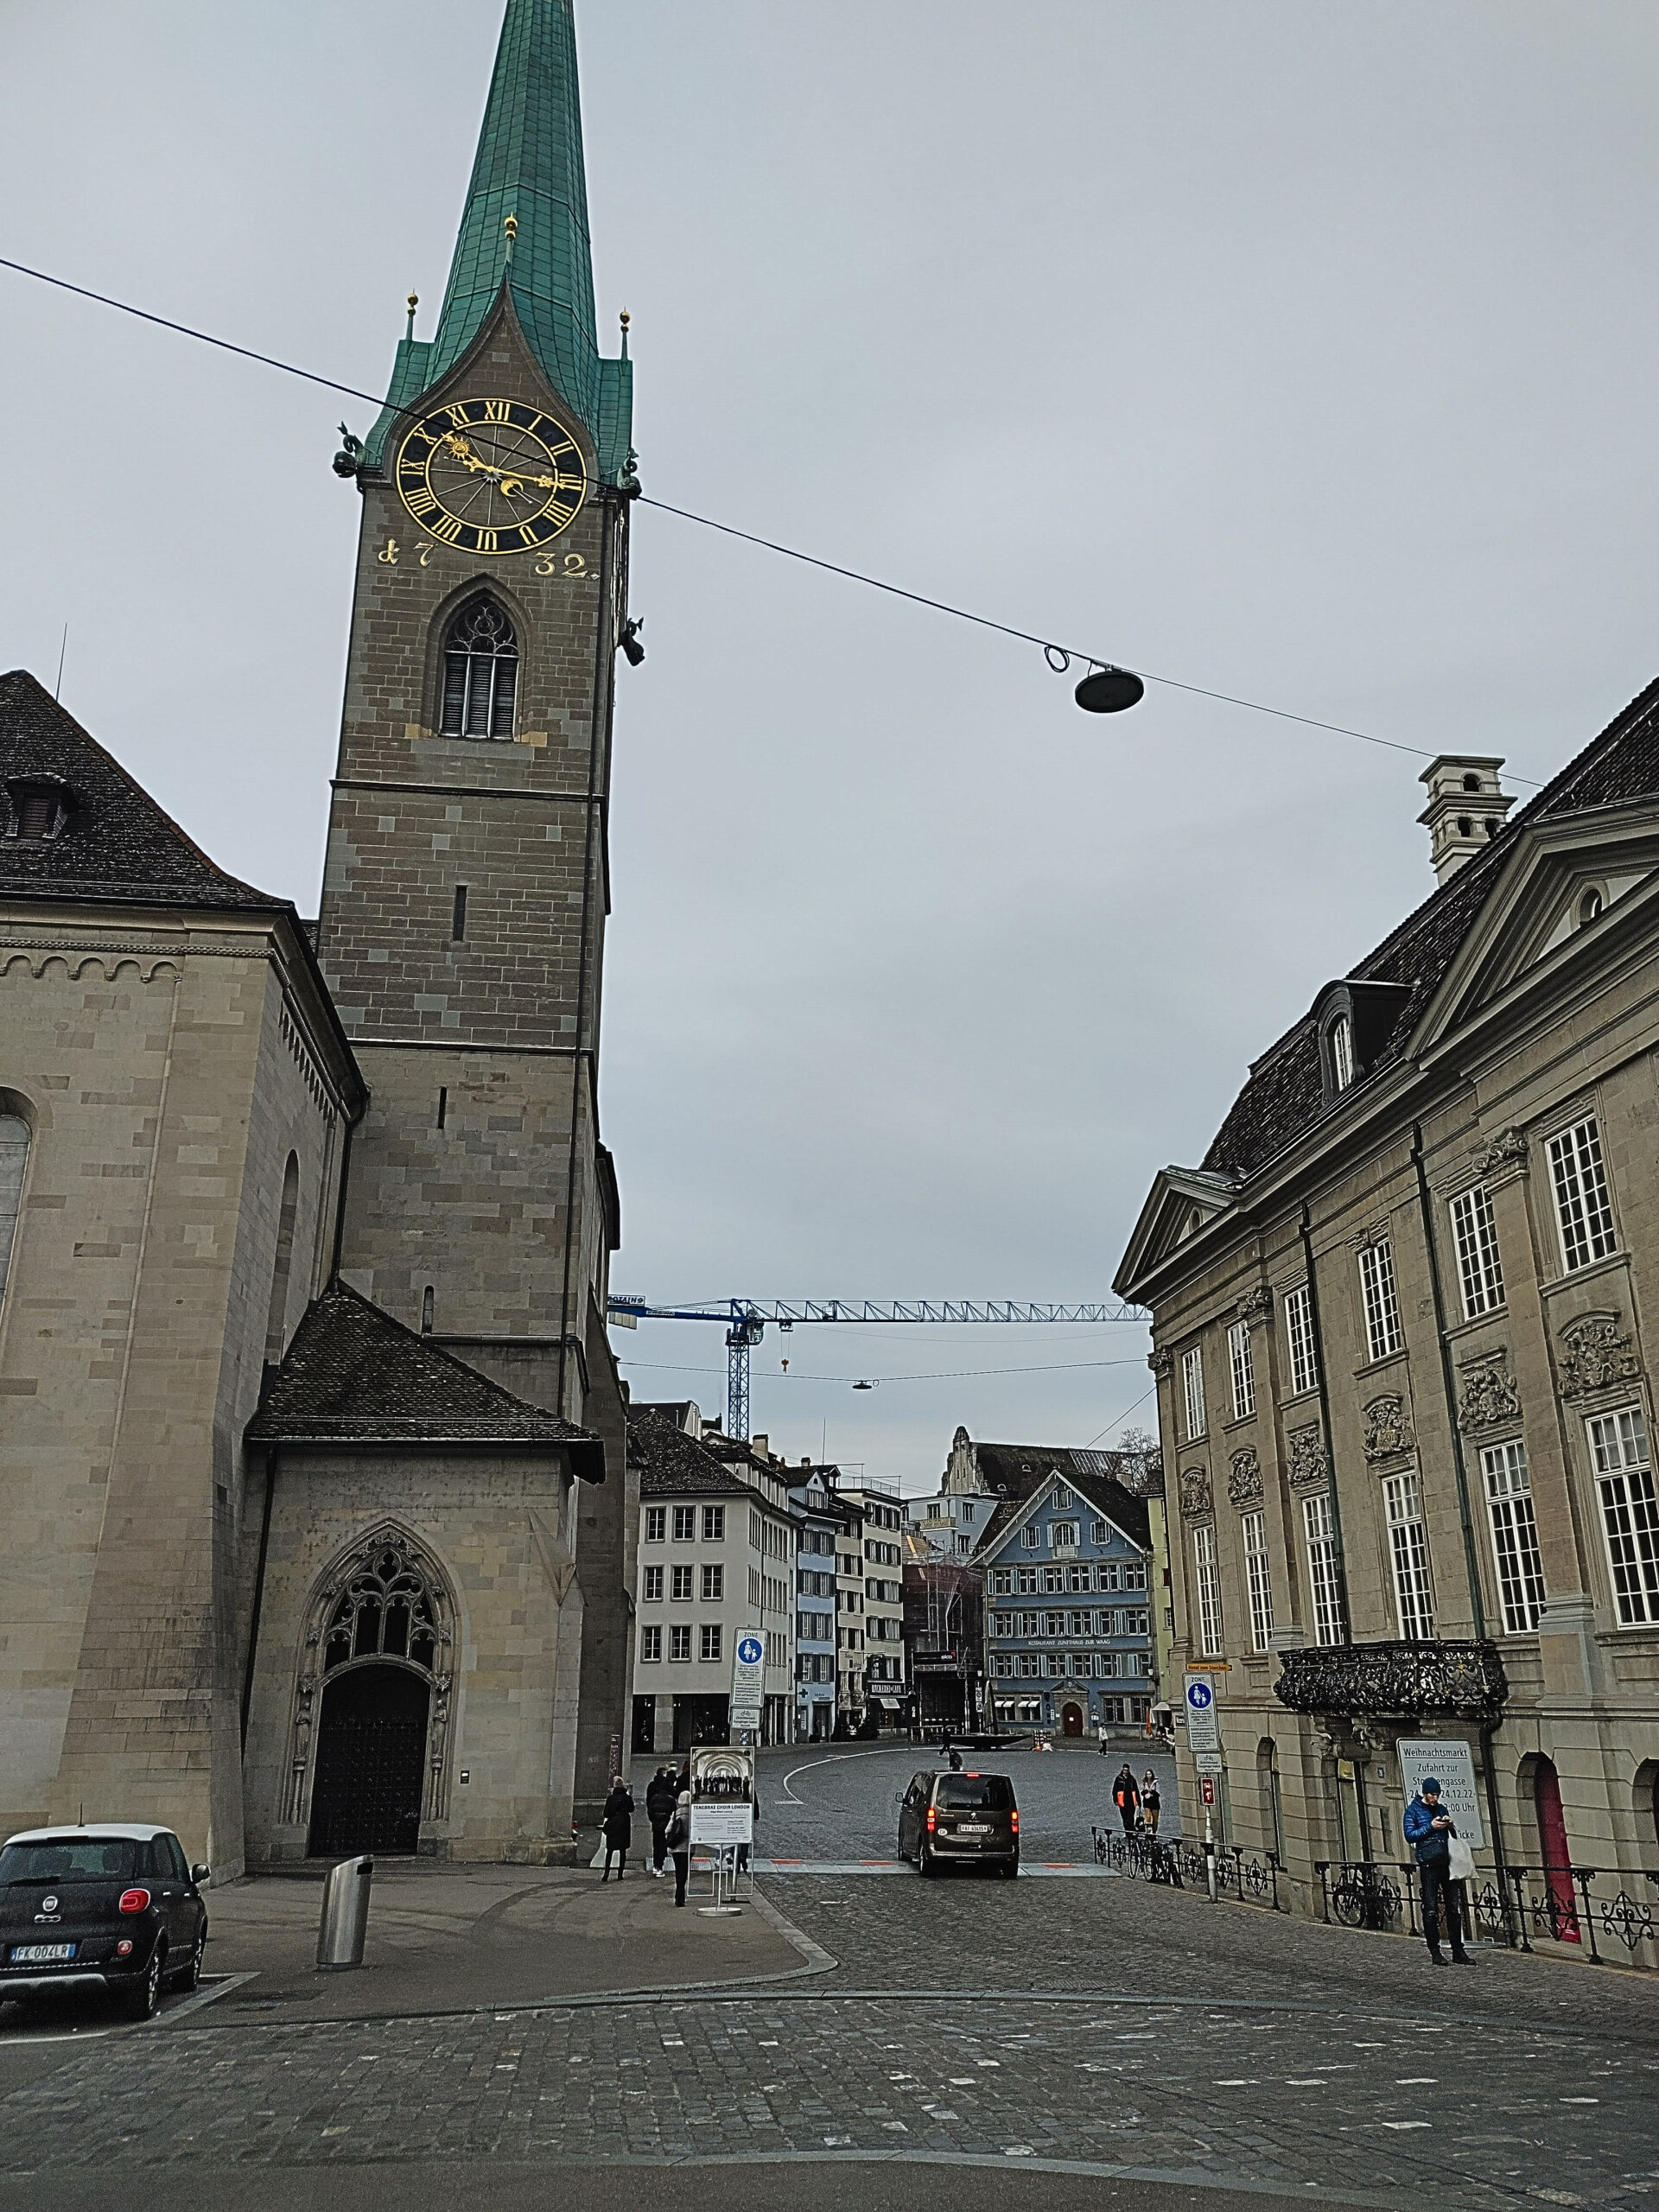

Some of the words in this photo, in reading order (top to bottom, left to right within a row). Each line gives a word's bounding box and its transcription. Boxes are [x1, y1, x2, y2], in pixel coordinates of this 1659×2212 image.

[446, 404, 469, 425] XI
[484, 401, 510, 421] XII
[528, 415, 543, 430] I
[413, 427, 438, 445] X
[550, 441, 575, 456] II
[400, 458, 425, 476] IX
[1403, 1747, 1467, 1757] Weihnachtsmarkt
[1417, 1763, 1445, 1772] Zufahrt
[1441, 1789, 1472, 1798] 24.12.22
[1462, 1802, 1475, 1812] Uhr
